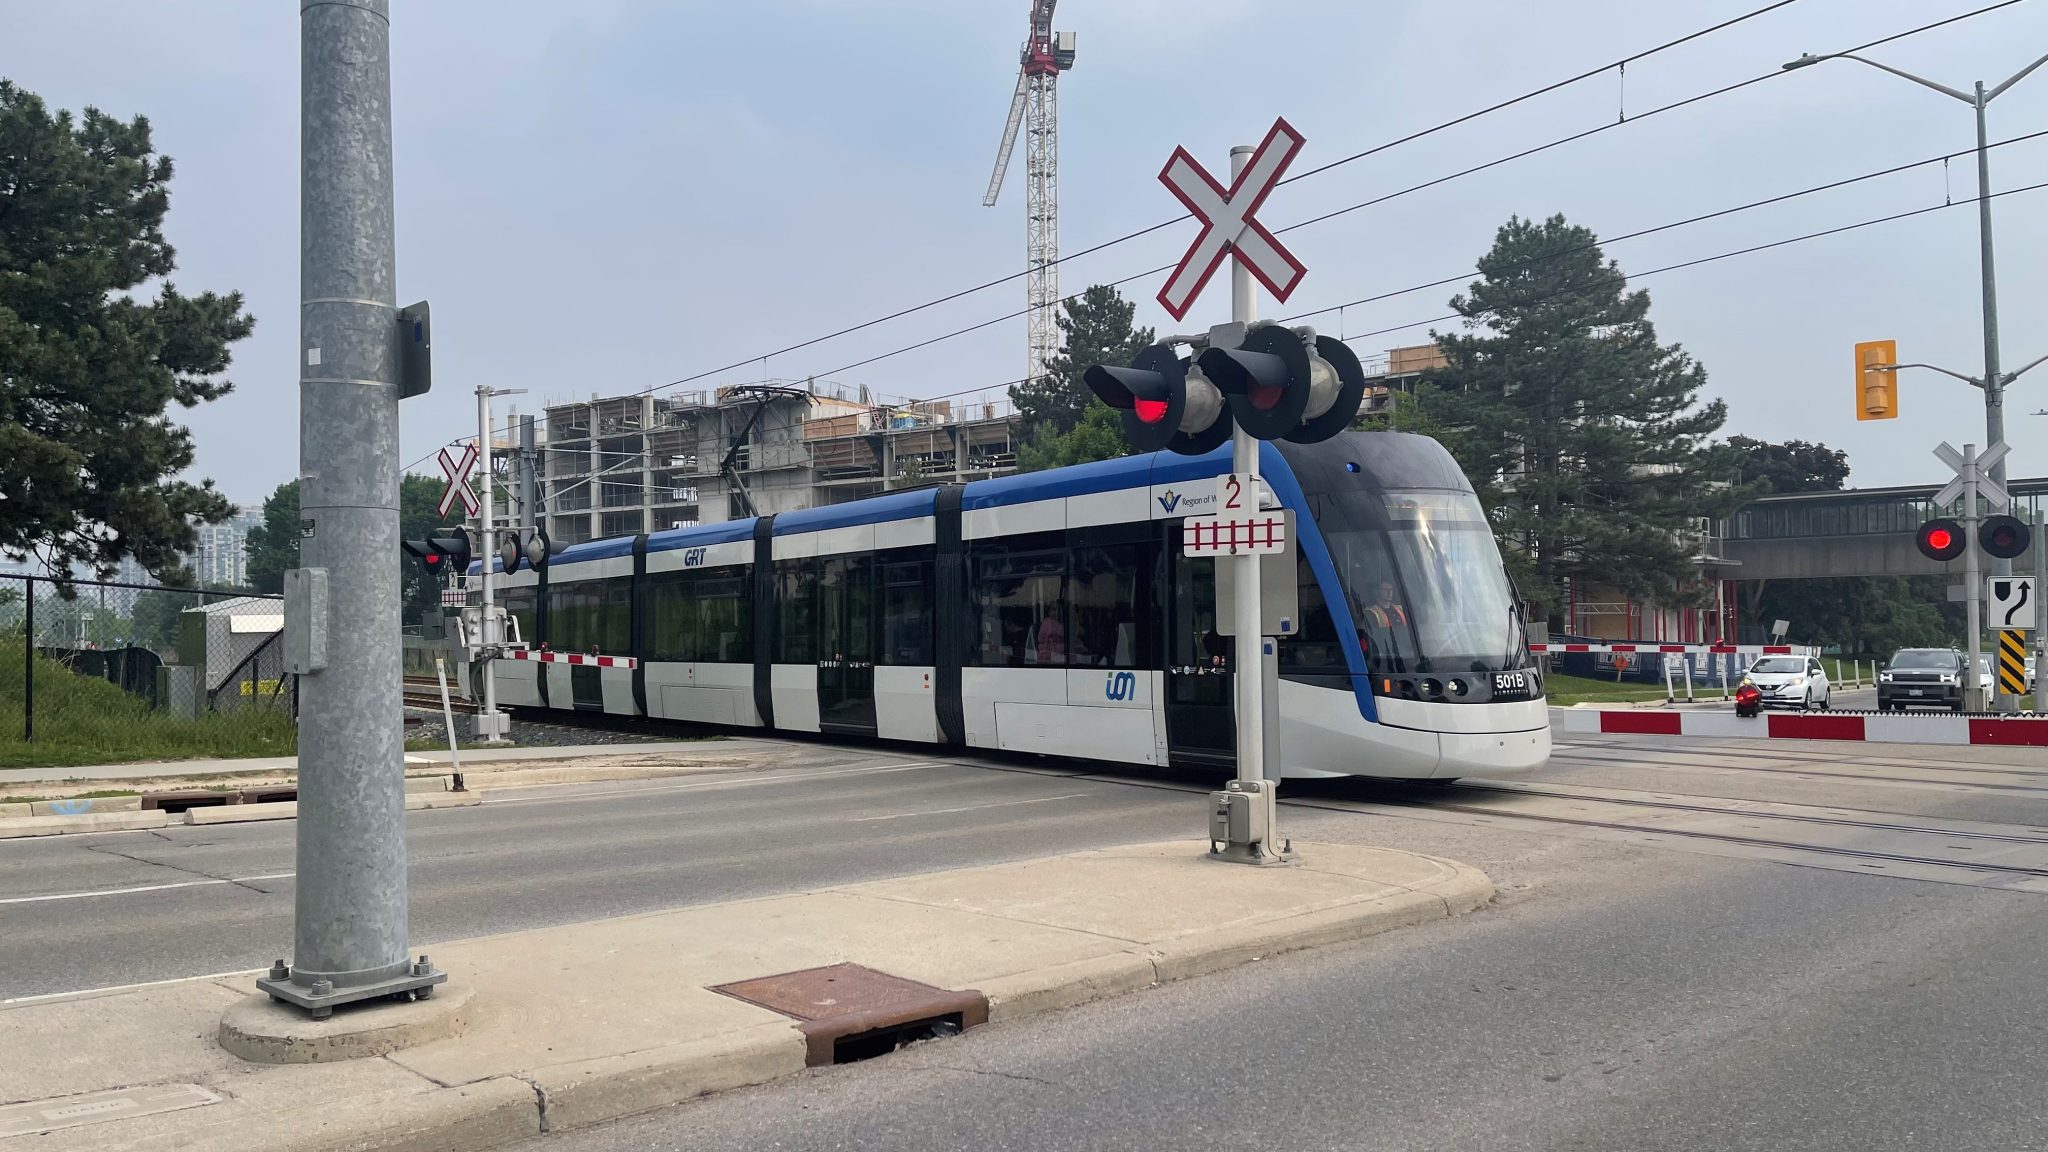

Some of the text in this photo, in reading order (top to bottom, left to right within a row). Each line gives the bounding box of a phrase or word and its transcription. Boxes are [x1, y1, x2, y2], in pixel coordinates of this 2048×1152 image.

[1182, 497, 1202, 507] Region
[1203, 495, 1210, 503] of
[1226, 480, 1241, 508] 2
[684, 547, 706, 566] GRT
[1496, 673, 1524, 688] 501B
